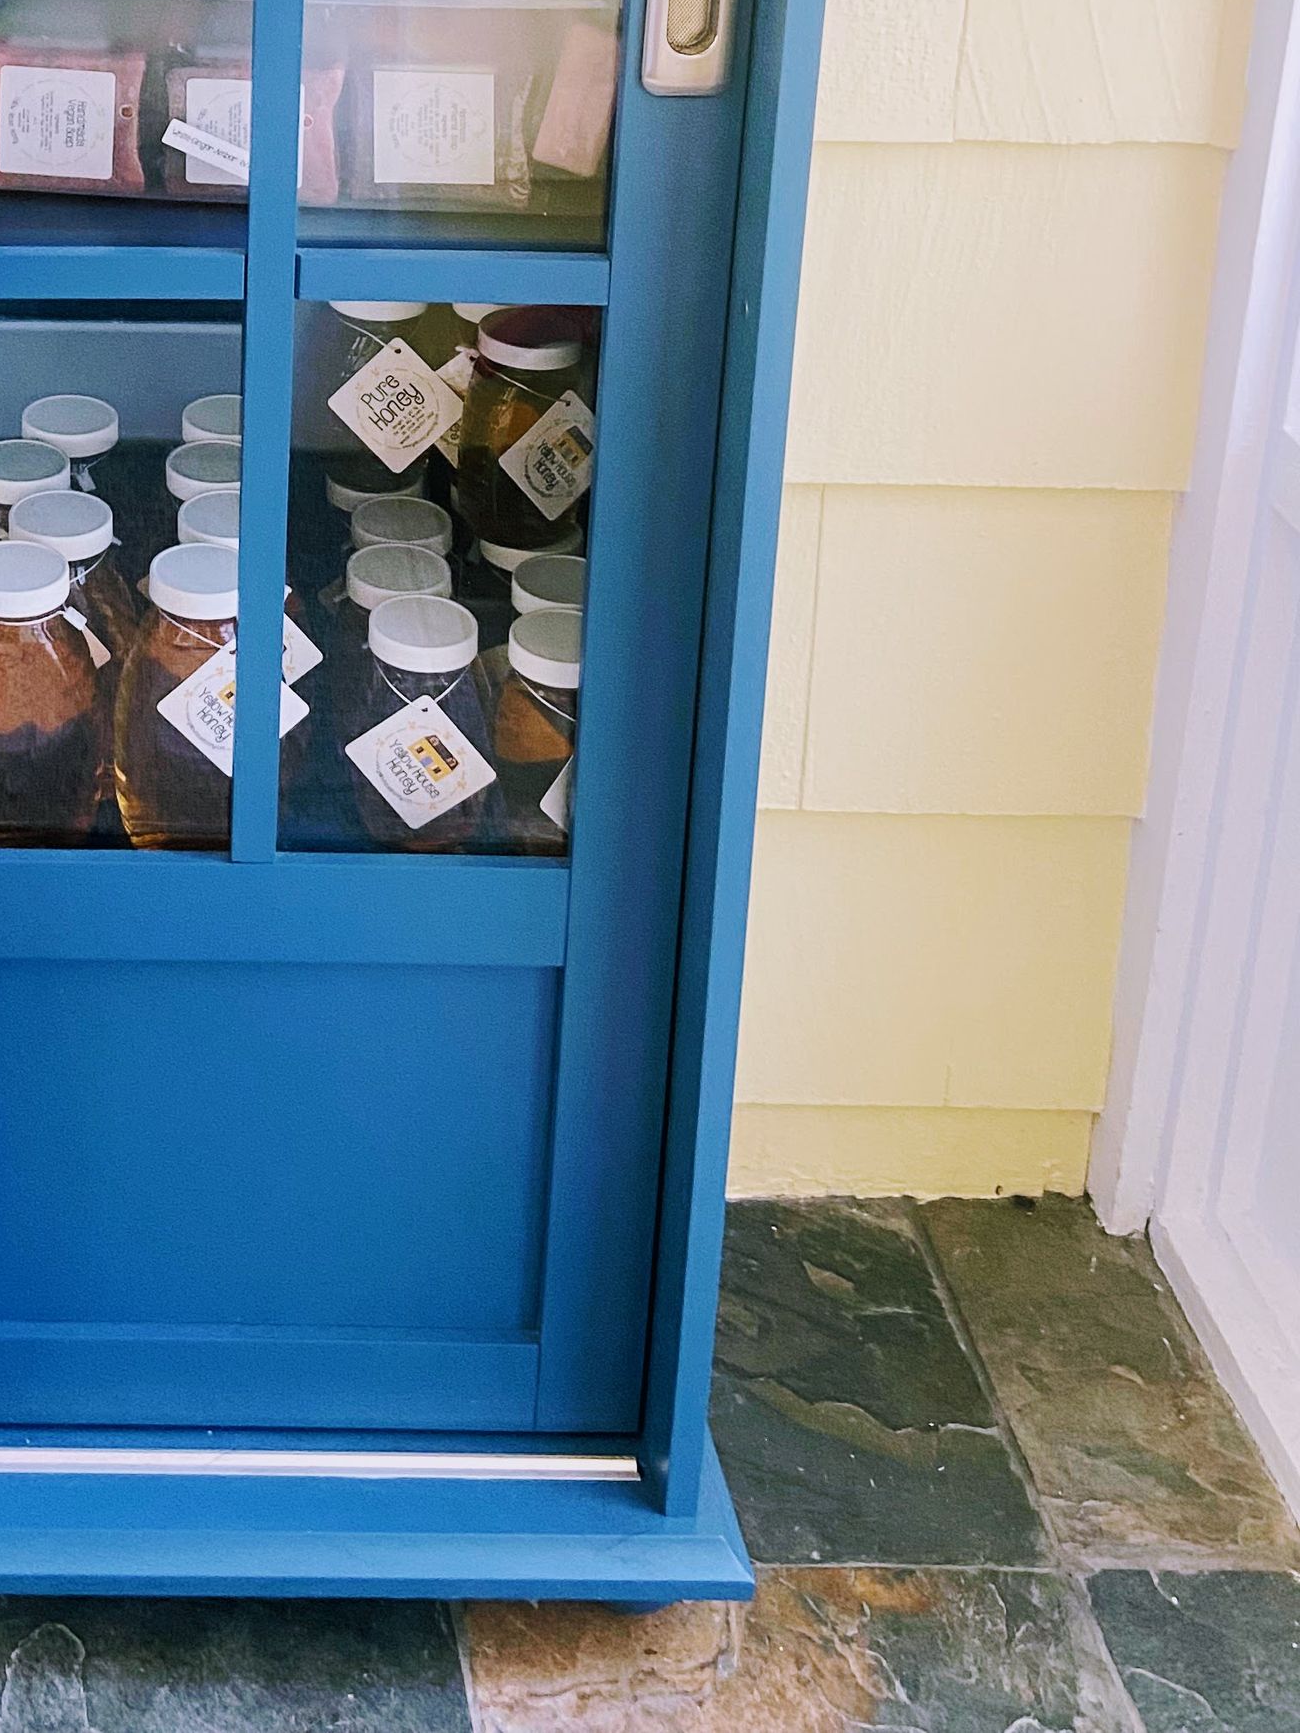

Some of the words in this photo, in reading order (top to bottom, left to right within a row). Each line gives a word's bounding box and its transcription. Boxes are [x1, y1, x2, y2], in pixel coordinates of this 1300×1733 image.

[360, 375, 400, 411] Pure
[368, 382, 425, 431] Honey
[198, 687, 229, 716] Yellow
[197, 706, 232, 743] Honey
[386, 757, 419, 796] Honey
[389, 739, 418, 769] Yellow
[412, 768, 440, 799] House
